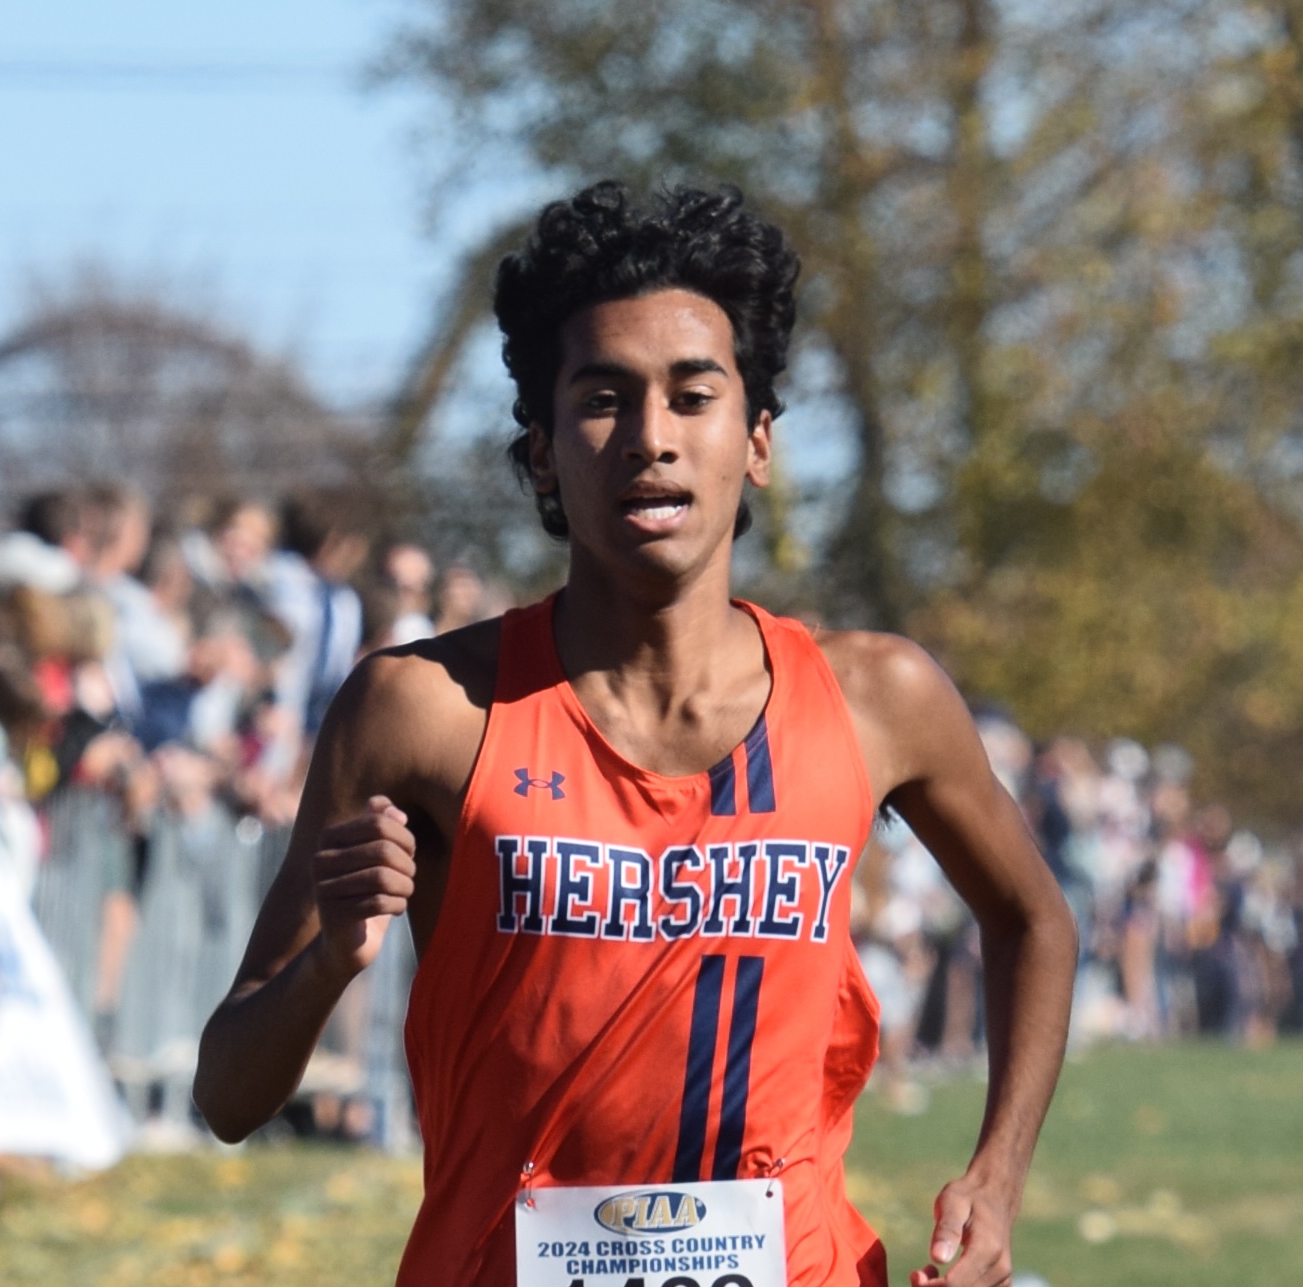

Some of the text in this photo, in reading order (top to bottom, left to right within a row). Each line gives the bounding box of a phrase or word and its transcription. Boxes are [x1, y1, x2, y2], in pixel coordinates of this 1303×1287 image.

[495, 835, 851, 943] HERSHEY
[609, 1194, 700, 1229] PIAA
[537, 1234, 766, 1258] 2024 CROSS COUNTRY
[566, 1254, 739, 1275] CHAMPIONSHIPS
